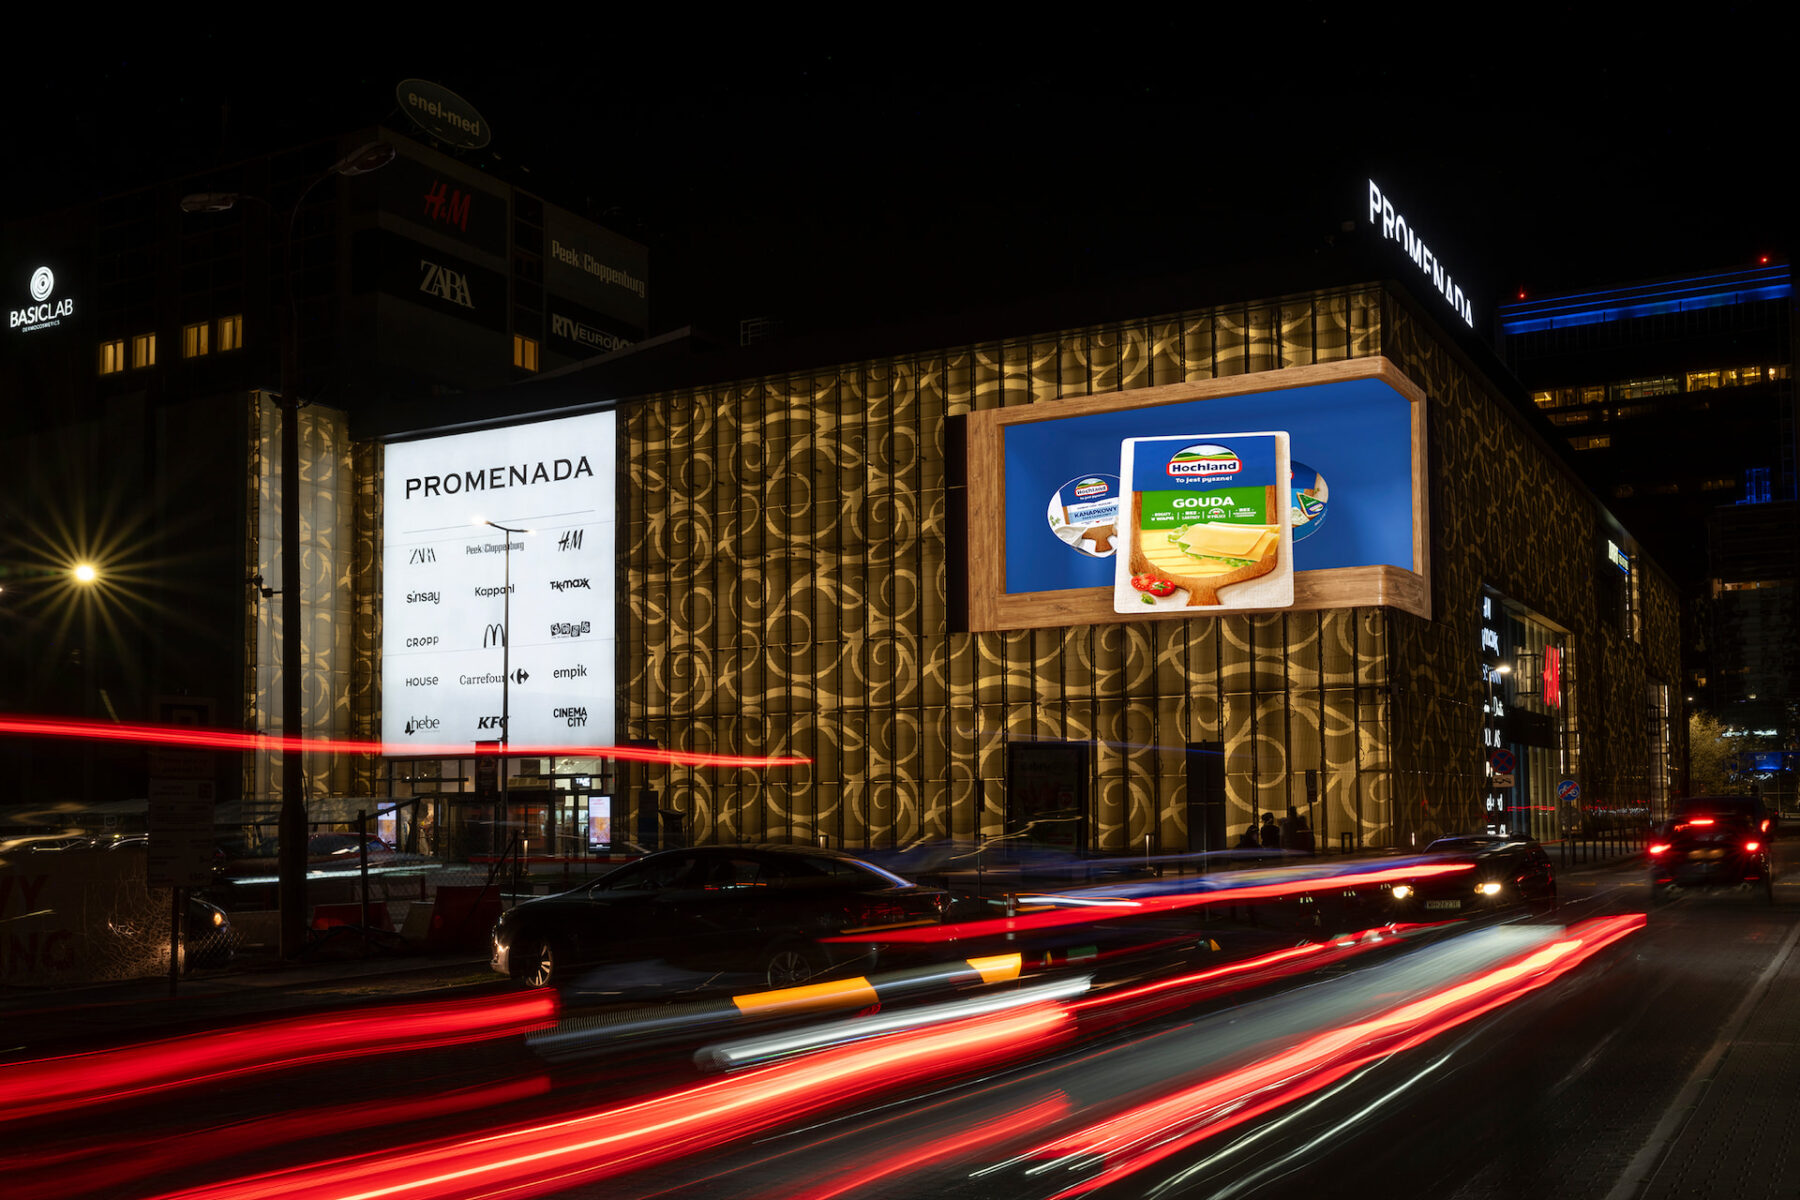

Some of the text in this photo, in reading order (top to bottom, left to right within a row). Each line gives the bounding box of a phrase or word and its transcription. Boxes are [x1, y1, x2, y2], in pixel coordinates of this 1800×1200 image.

[408, 92, 481, 137] enel-med
[424, 178, 472, 233] H&M
[1367, 178, 1475, 329] PROMENADA
[551, 239, 646, 299] Peek Cloppenburg
[419, 258, 477, 310] ZARA
[9, 298, 74, 328] BASICLAB
[551, 312, 579, 342] RTV
[1172, 461, 1237, 473] Hochland
[405, 455, 594, 500] PROMENADA
[1172, 496, 1235, 509] GOUDA
[1074, 506, 1118, 518] KANAPKOWY
[484, 541, 525, 554] Cloppeburg
[557, 528, 584, 552] H&M
[406, 590, 441, 605] sinsay
[406, 635, 440, 648] CROPP
[553, 663, 588, 680] empik
[553, 706, 588, 718] CINEMA
[411, 714, 441, 730] hebe
[567, 716, 588, 728] CITY
